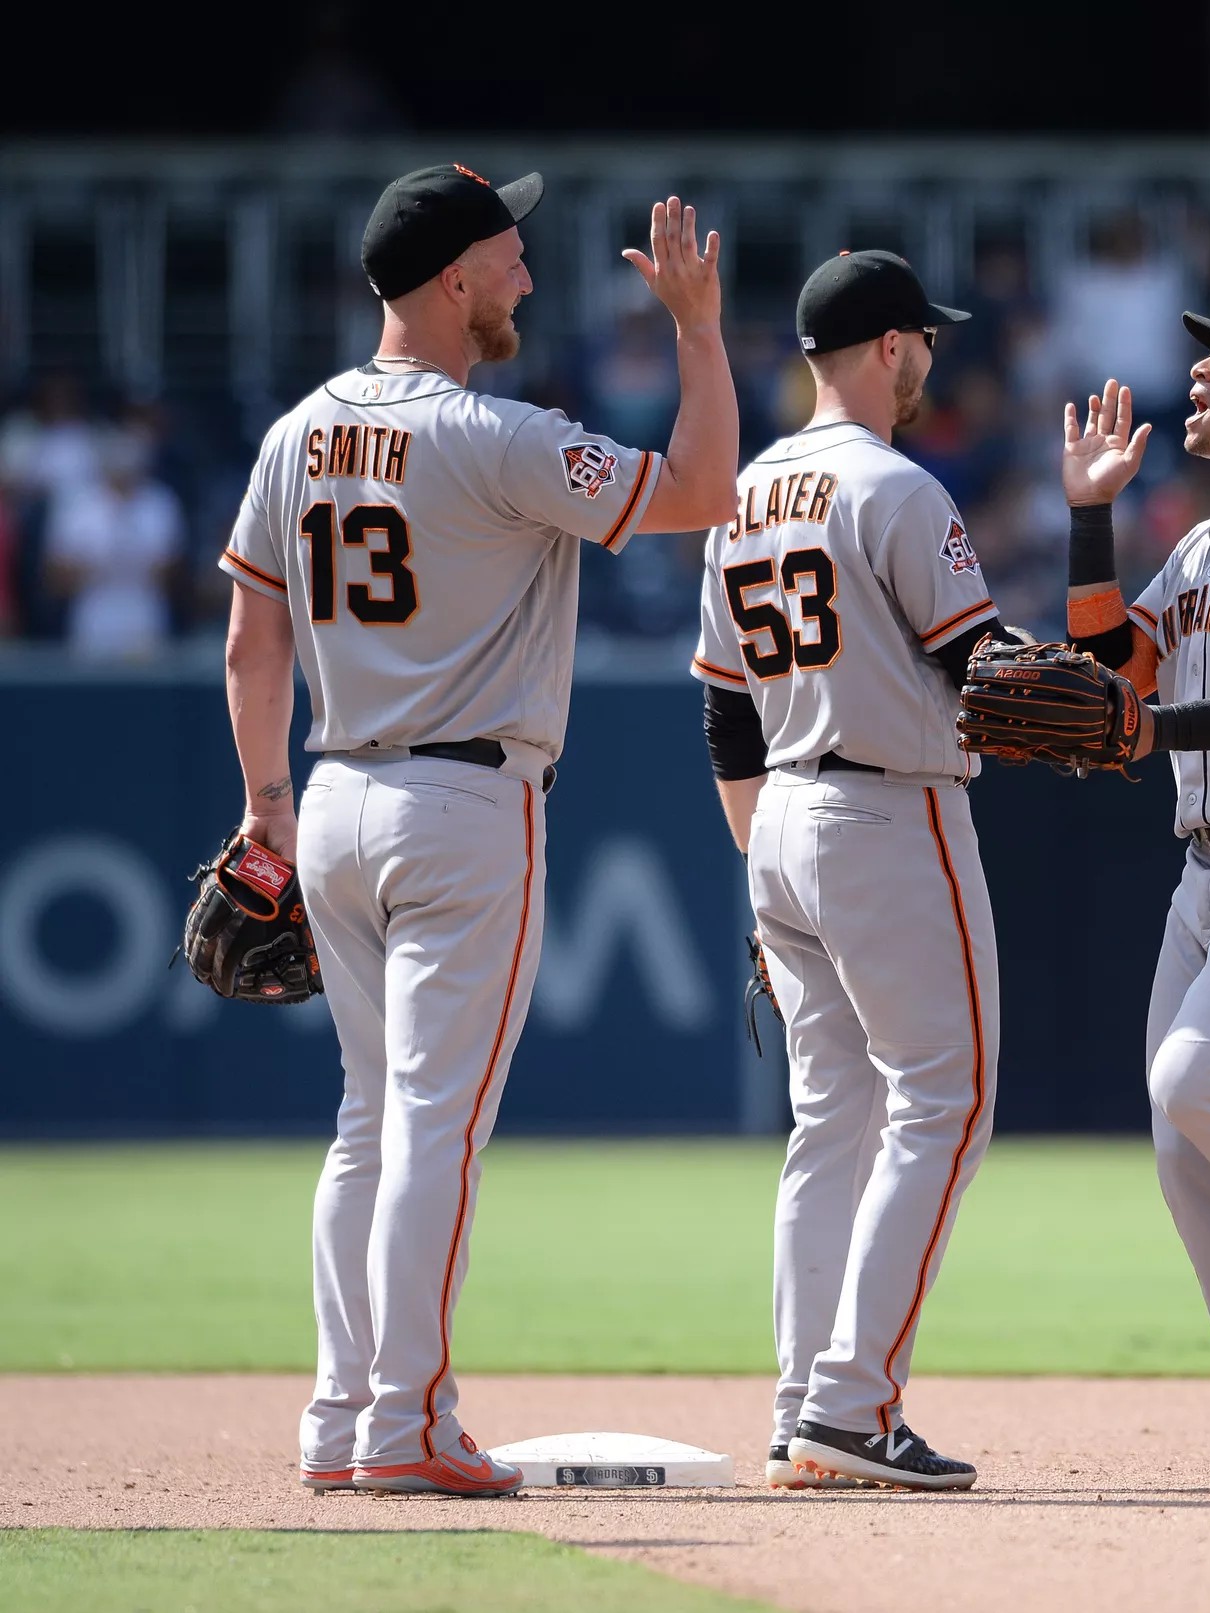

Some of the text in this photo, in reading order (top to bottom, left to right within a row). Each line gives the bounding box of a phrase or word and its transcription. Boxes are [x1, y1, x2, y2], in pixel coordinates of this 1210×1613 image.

[307, 424, 412, 484] SMITH
[571, 446, 607, 489] 60
[300, 501, 421, 627] 13
[948, 533, 974, 562] 60
[722, 545, 844, 682] 53
[994, 668, 1041, 680] A2000
